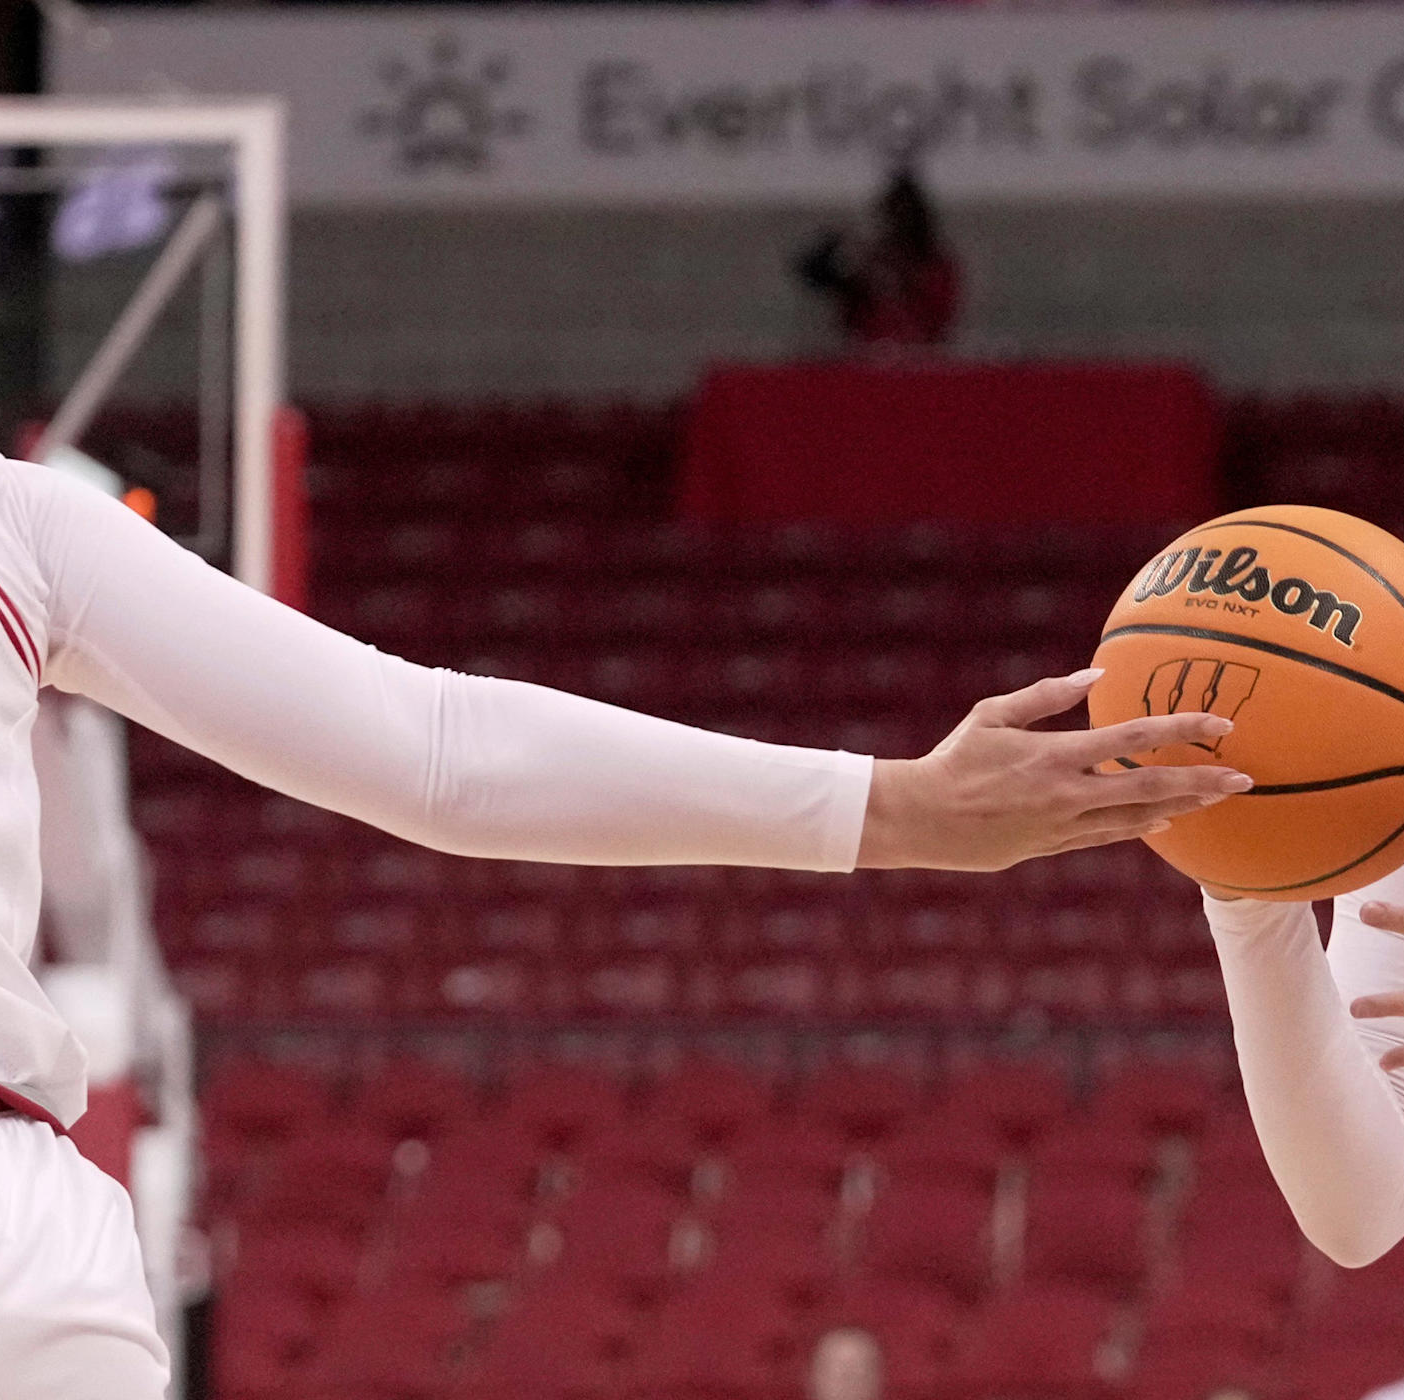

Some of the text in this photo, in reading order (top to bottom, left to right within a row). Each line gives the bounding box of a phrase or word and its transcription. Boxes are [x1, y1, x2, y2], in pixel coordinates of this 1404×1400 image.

[1134, 546, 1363, 648] Wilson
[1185, 597, 1261, 618] EVO NXT
